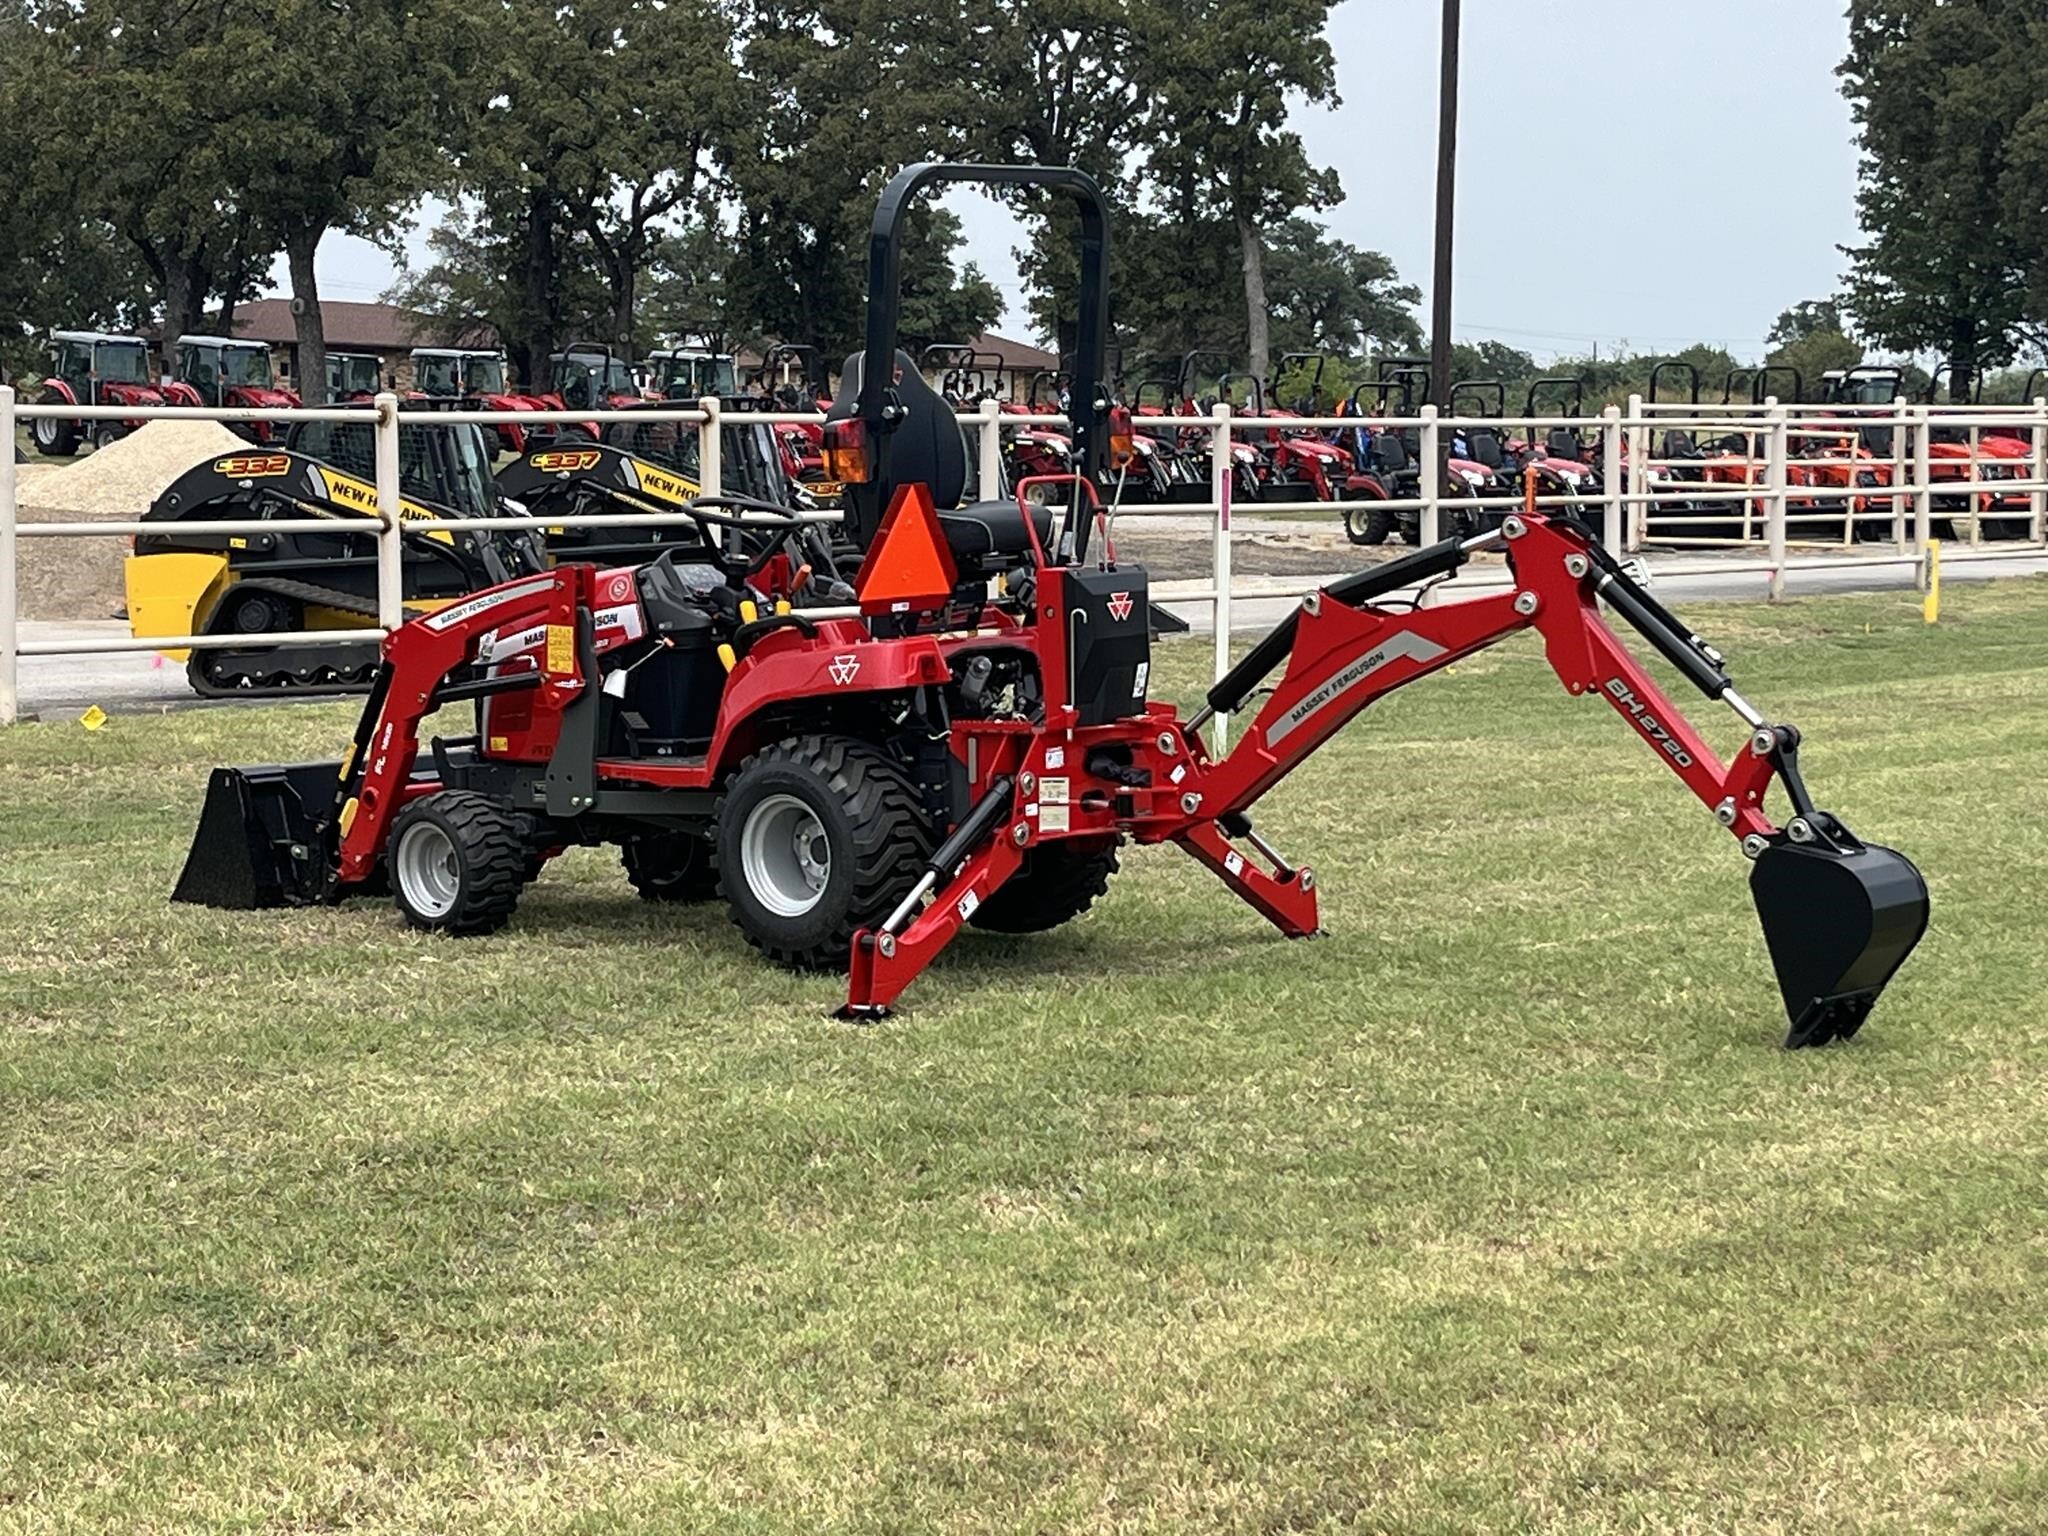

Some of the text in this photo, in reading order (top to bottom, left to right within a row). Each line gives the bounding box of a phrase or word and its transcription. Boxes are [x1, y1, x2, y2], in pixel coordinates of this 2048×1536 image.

[214, 454, 291, 478] C332
[530, 451, 602, 472] C337
[333, 481, 365, 502] NEW
[643, 473, 675, 493] NEW
[524, 630, 545, 646] MAS
[1291, 651, 1385, 722] MASSEY FERGUSON
